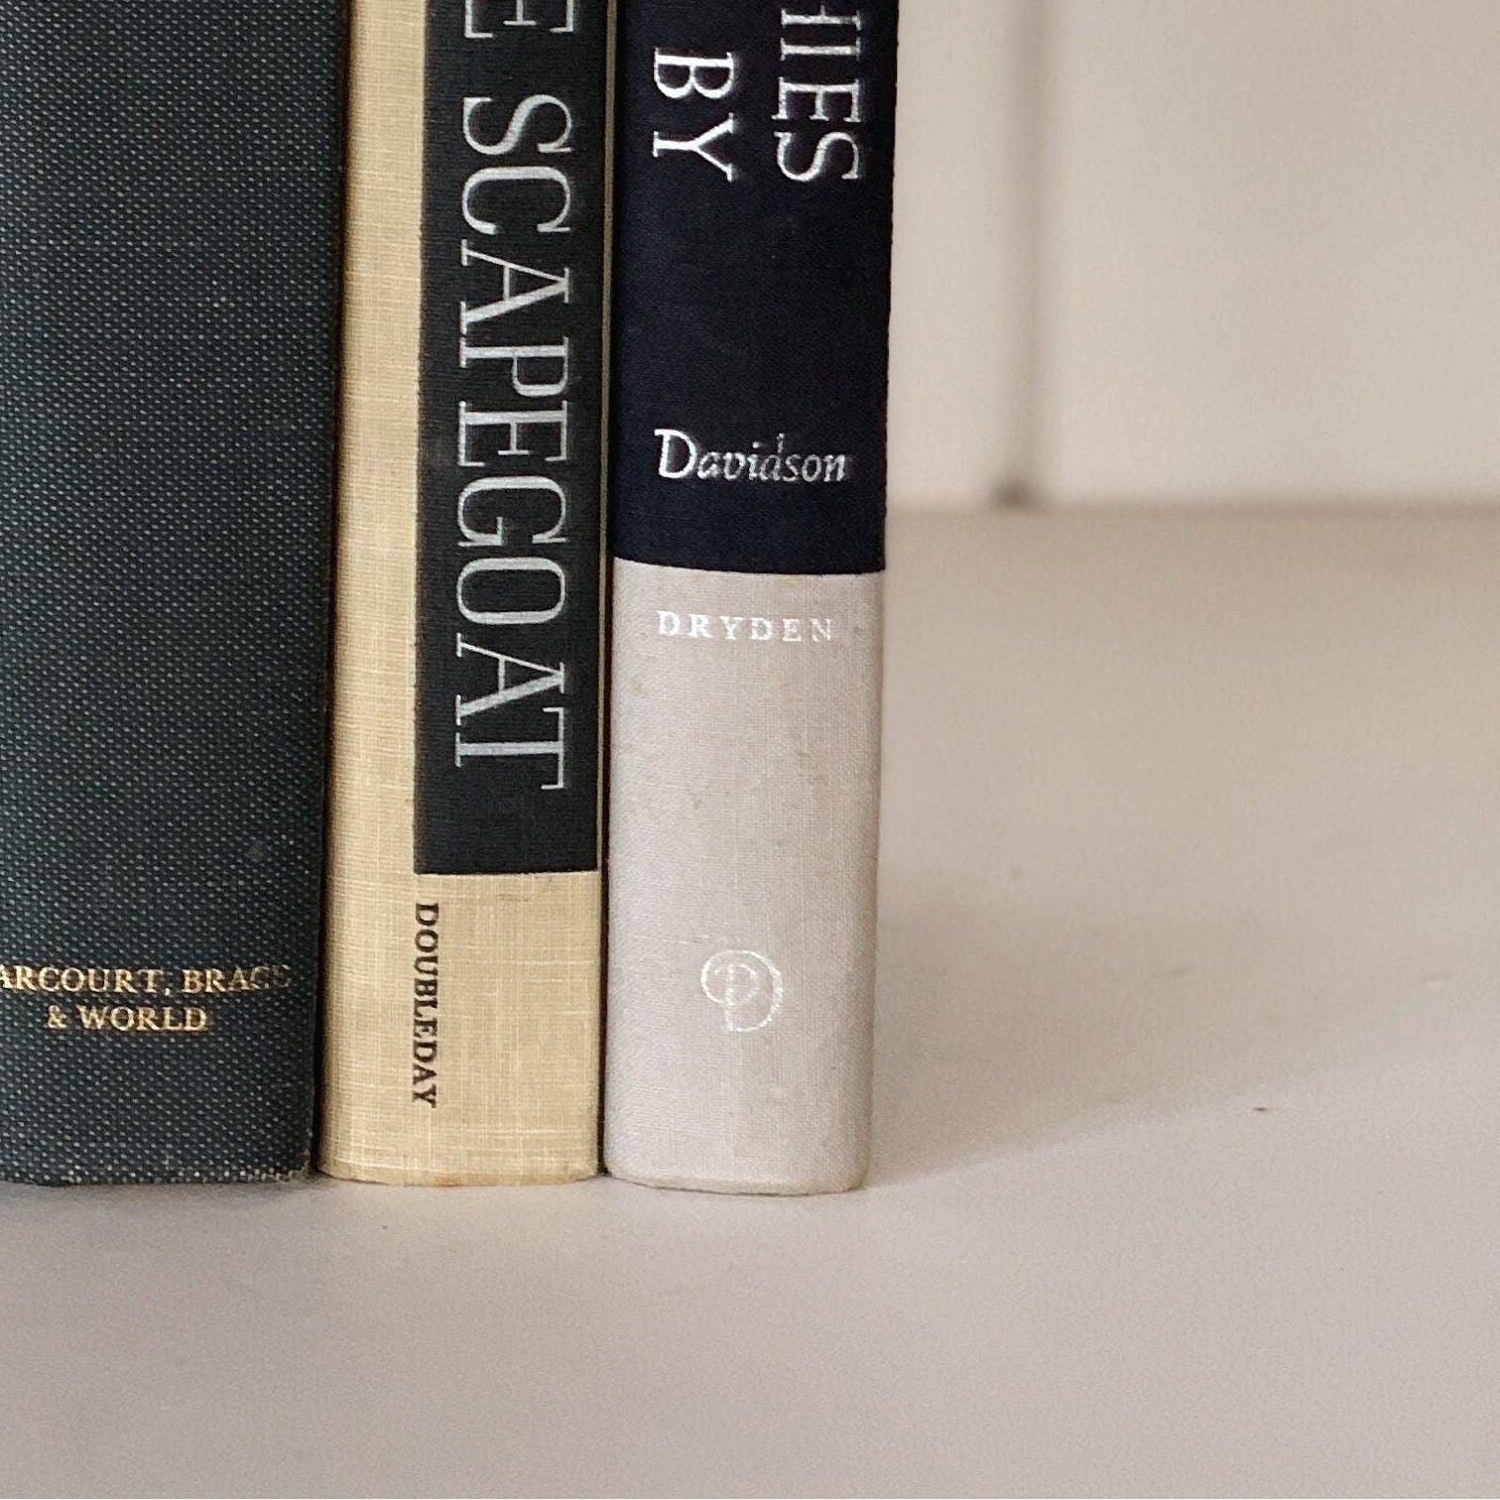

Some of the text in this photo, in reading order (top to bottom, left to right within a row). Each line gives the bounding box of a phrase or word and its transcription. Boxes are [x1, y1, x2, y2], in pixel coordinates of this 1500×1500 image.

[651, 46, 739, 183] BY
[454, 93, 574, 790] SCAPEGOAT
[654, 428, 850, 485] Davidson
[656, 609, 836, 643] DRYDEN
[46, 1005, 208, 1033] & WORLD
[411, 902, 440, 1108] DOUBLEDAY
